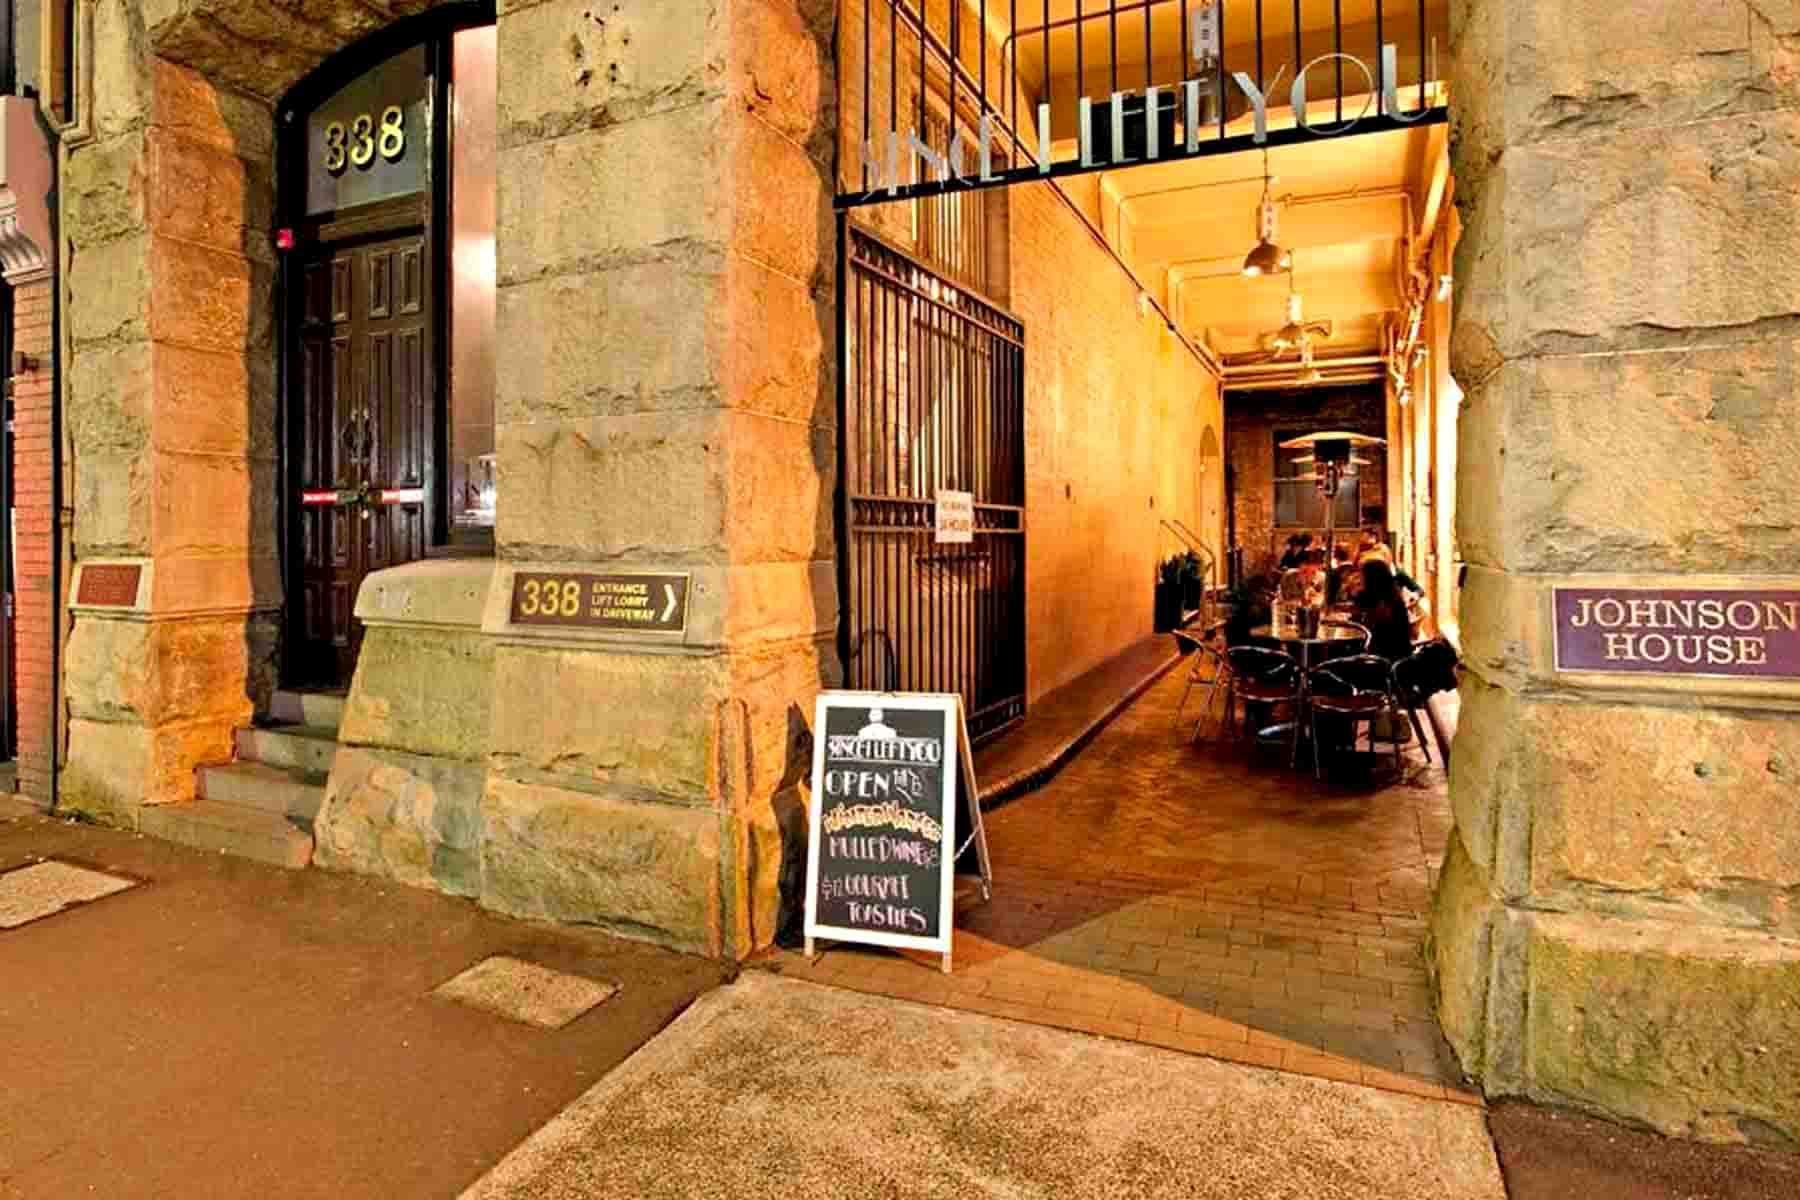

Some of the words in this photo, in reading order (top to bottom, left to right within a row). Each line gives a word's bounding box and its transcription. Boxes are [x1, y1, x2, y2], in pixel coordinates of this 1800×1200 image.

[1231, 36, 1437, 144] YOU
[324, 106, 404, 172] 338
[520, 579, 581, 616] 338
[591, 583, 649, 594] ENTRANCE
[591, 595, 613, 606] LIFT
[614, 595, 649, 607] LOBBY
[590, 608, 600, 618] IN
[602, 608, 656, 622] DRIVEWAY
[1570, 598, 1800, 631] JOHNSON
[1602, 632, 1767, 665] HOUSE
[905, 740, 941, 762] YOU
[825, 769, 890, 799] OPEN
[829, 836, 890, 862] MULLED
[846, 901, 928, 932] TOASTIES
